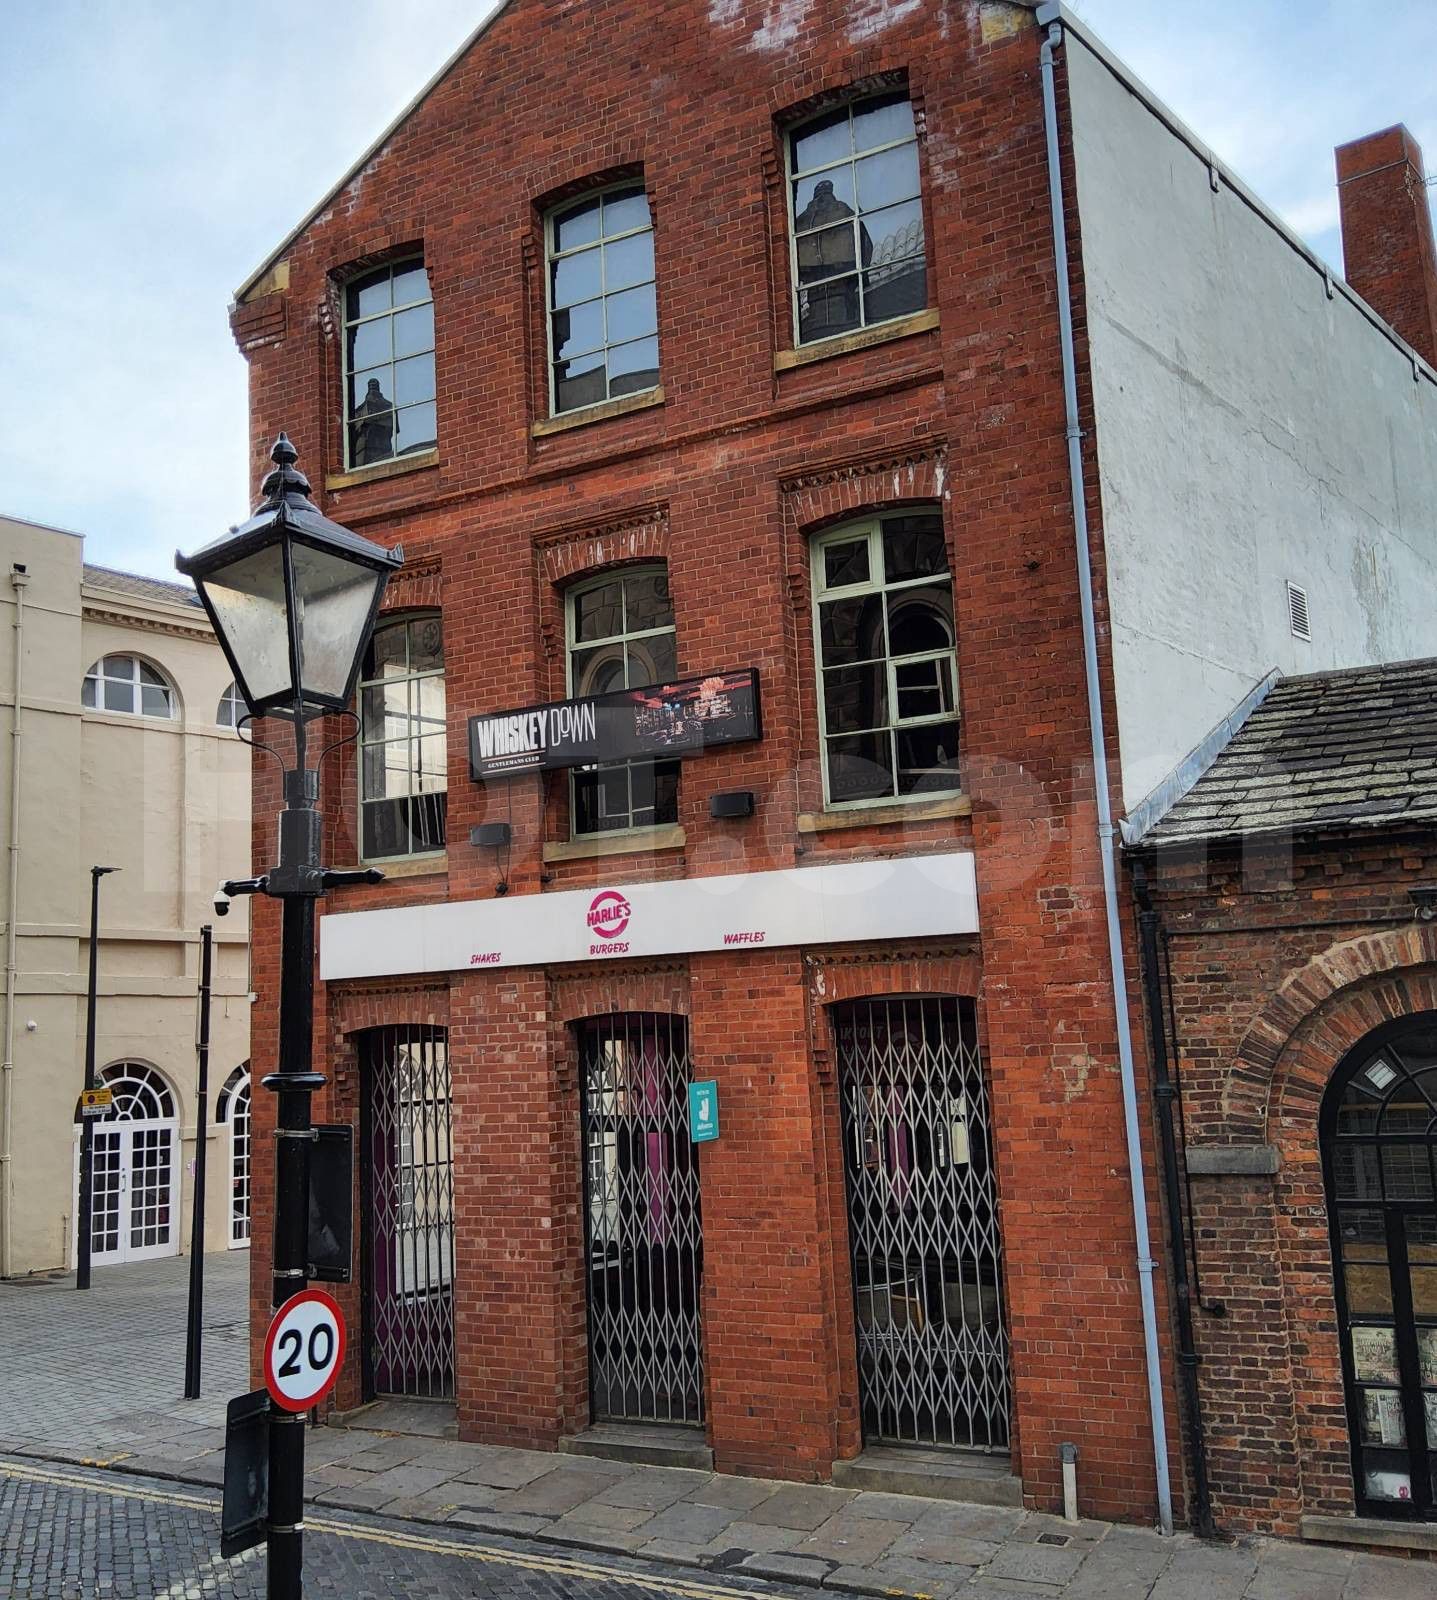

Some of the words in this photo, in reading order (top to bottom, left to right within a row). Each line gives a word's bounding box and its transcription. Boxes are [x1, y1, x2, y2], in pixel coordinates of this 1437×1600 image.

[478, 711, 548, 758] WHISKEY
[551, 702, 596, 747] DOWN
[525, 755, 541, 764] CLUB
[587, 902, 632, 927] HARLIE'S
[723, 931, 766, 945] WAFFLES
[590, 942, 630, 955] BURGERS
[470, 953, 502, 965] SHAKES
[278, 1323, 334, 1378] 20
